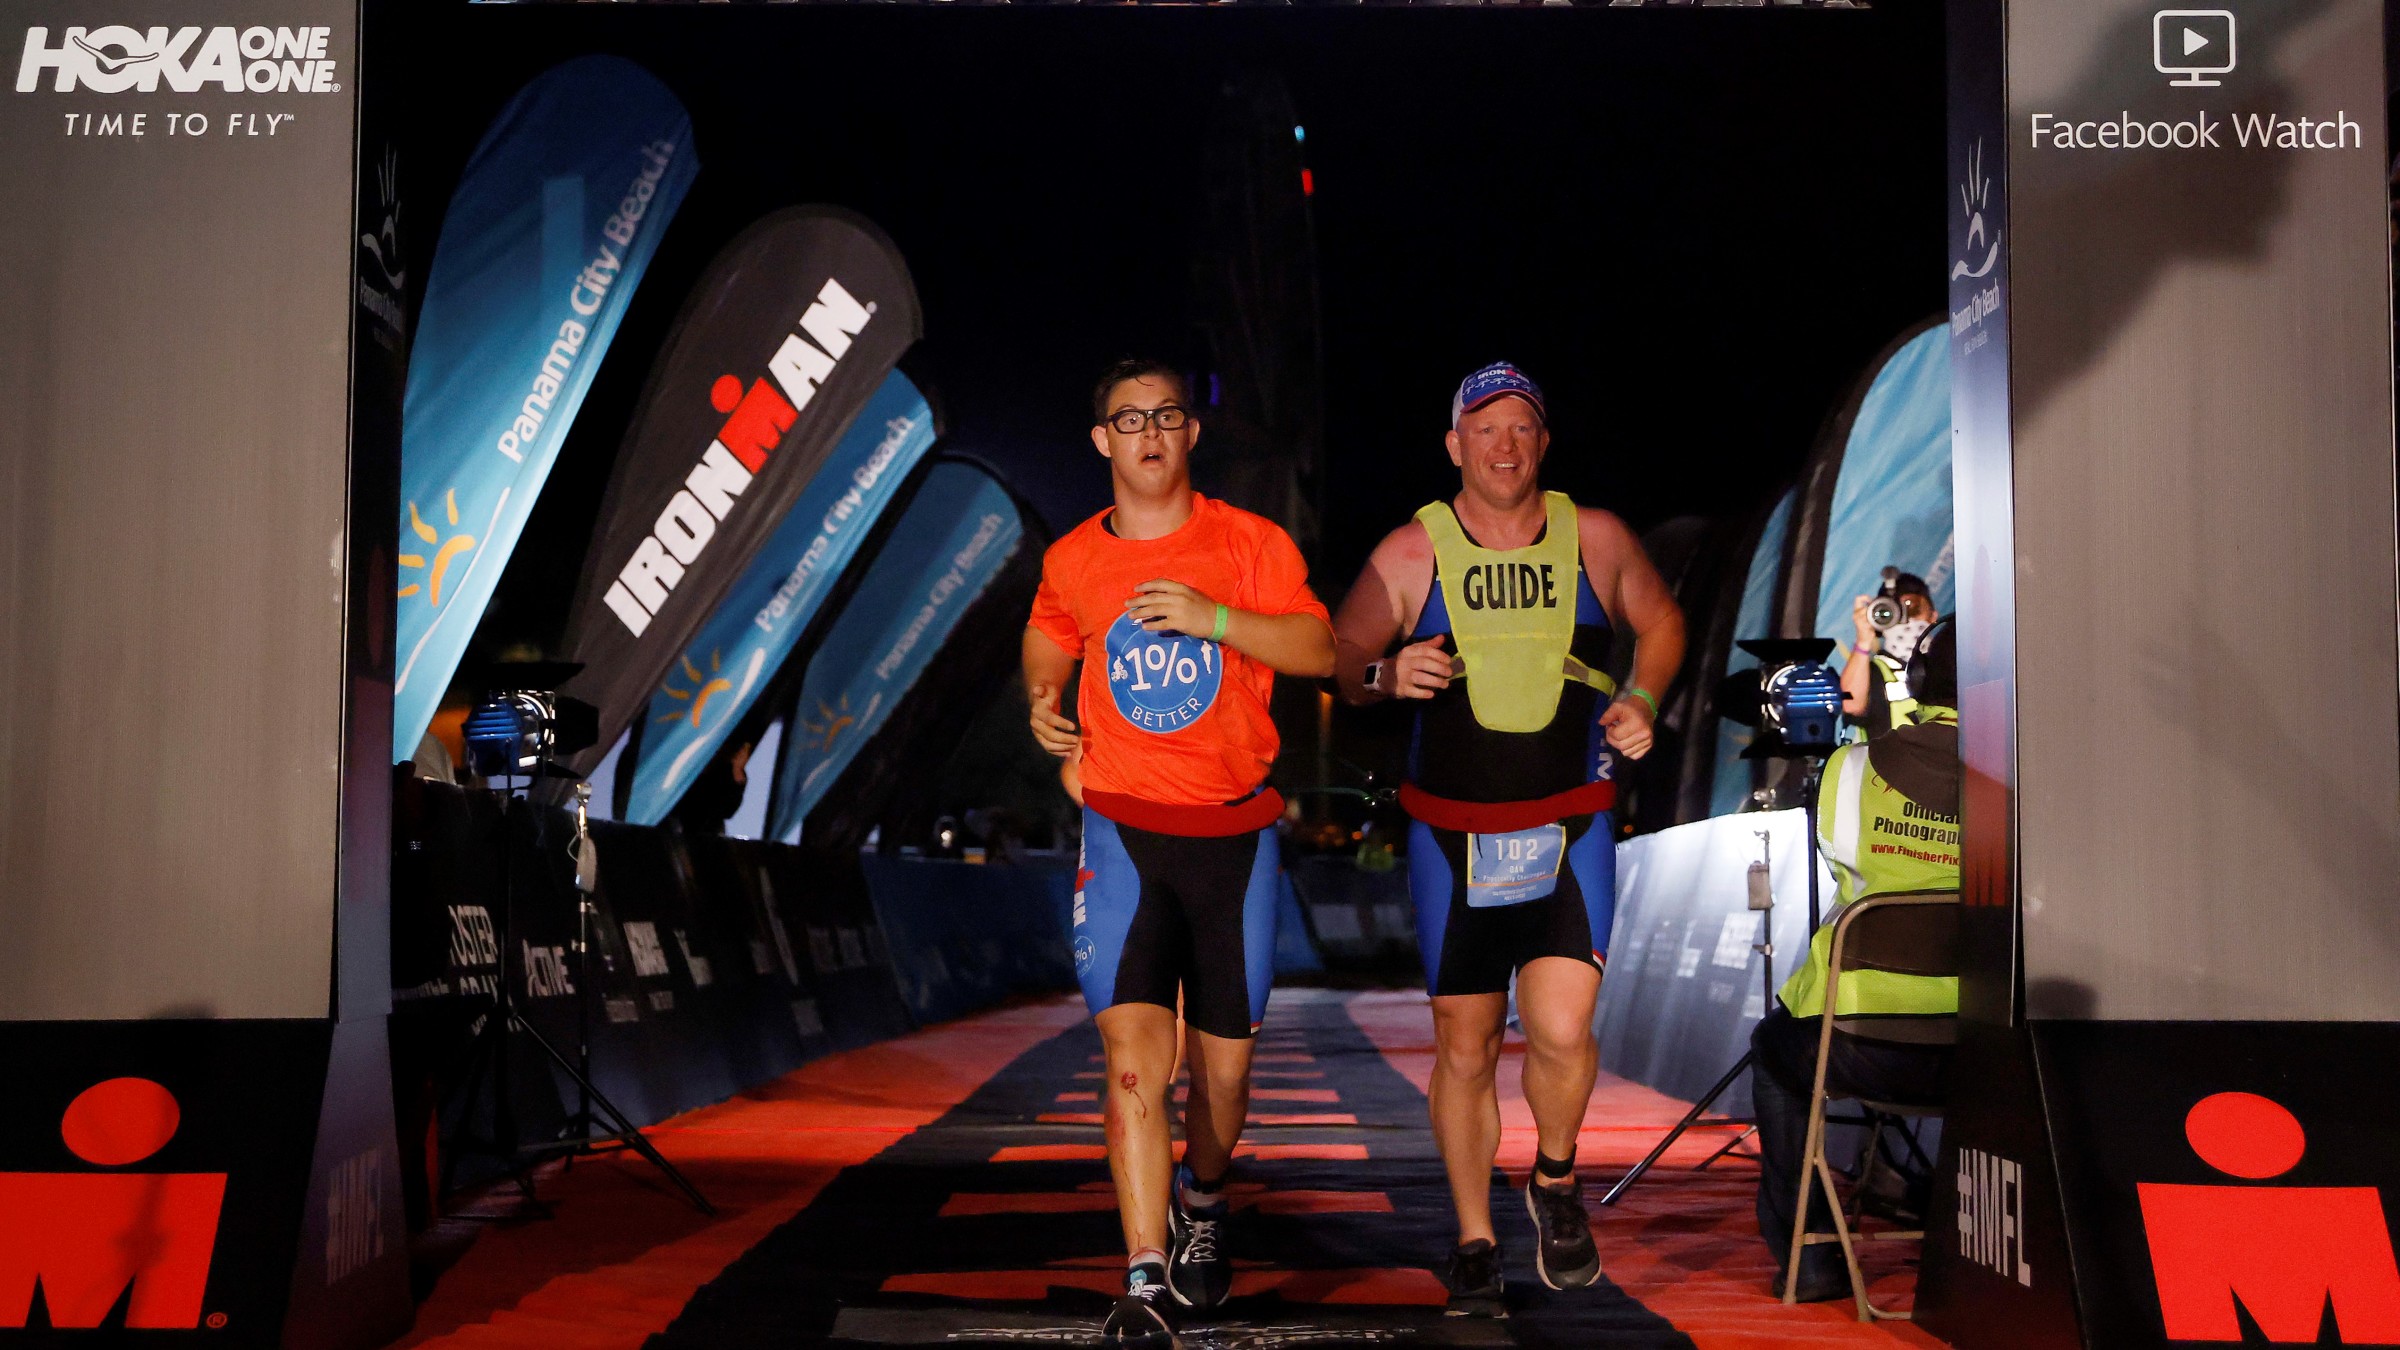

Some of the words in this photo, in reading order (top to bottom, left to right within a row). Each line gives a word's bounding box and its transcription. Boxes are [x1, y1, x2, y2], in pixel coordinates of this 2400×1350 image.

[15, 25, 245, 93] HOKA
[240, 26, 330, 59] ONE
[245, 60, 336, 93] ONE
[64, 113, 147, 136] TIME
[166, 113, 208, 136] TO
[2031, 110, 2220, 149] Facebook
[2231, 110, 2361, 149] Watch
[497, 319, 586, 464] Panama
[570, 244, 621, 316] City
[603, 140, 674, 247] Beach
[1982, 277, 2000, 317] Beach
[603, 277, 870, 639] IRONMAN
[754, 535, 828, 633] Panama
[823, 486, 863, 534] City
[853, 416, 914, 490] Beach
[1463, 563, 1557, 610] GUIDE
[1125, 642, 1198, 692] 1%
[1131, 697, 1202, 728] BETTER
[1495, 838, 1538, 861] 102
[1874, 816, 1960, 845] Photograp
[1956, 1147, 2031, 1288] #IMFL
